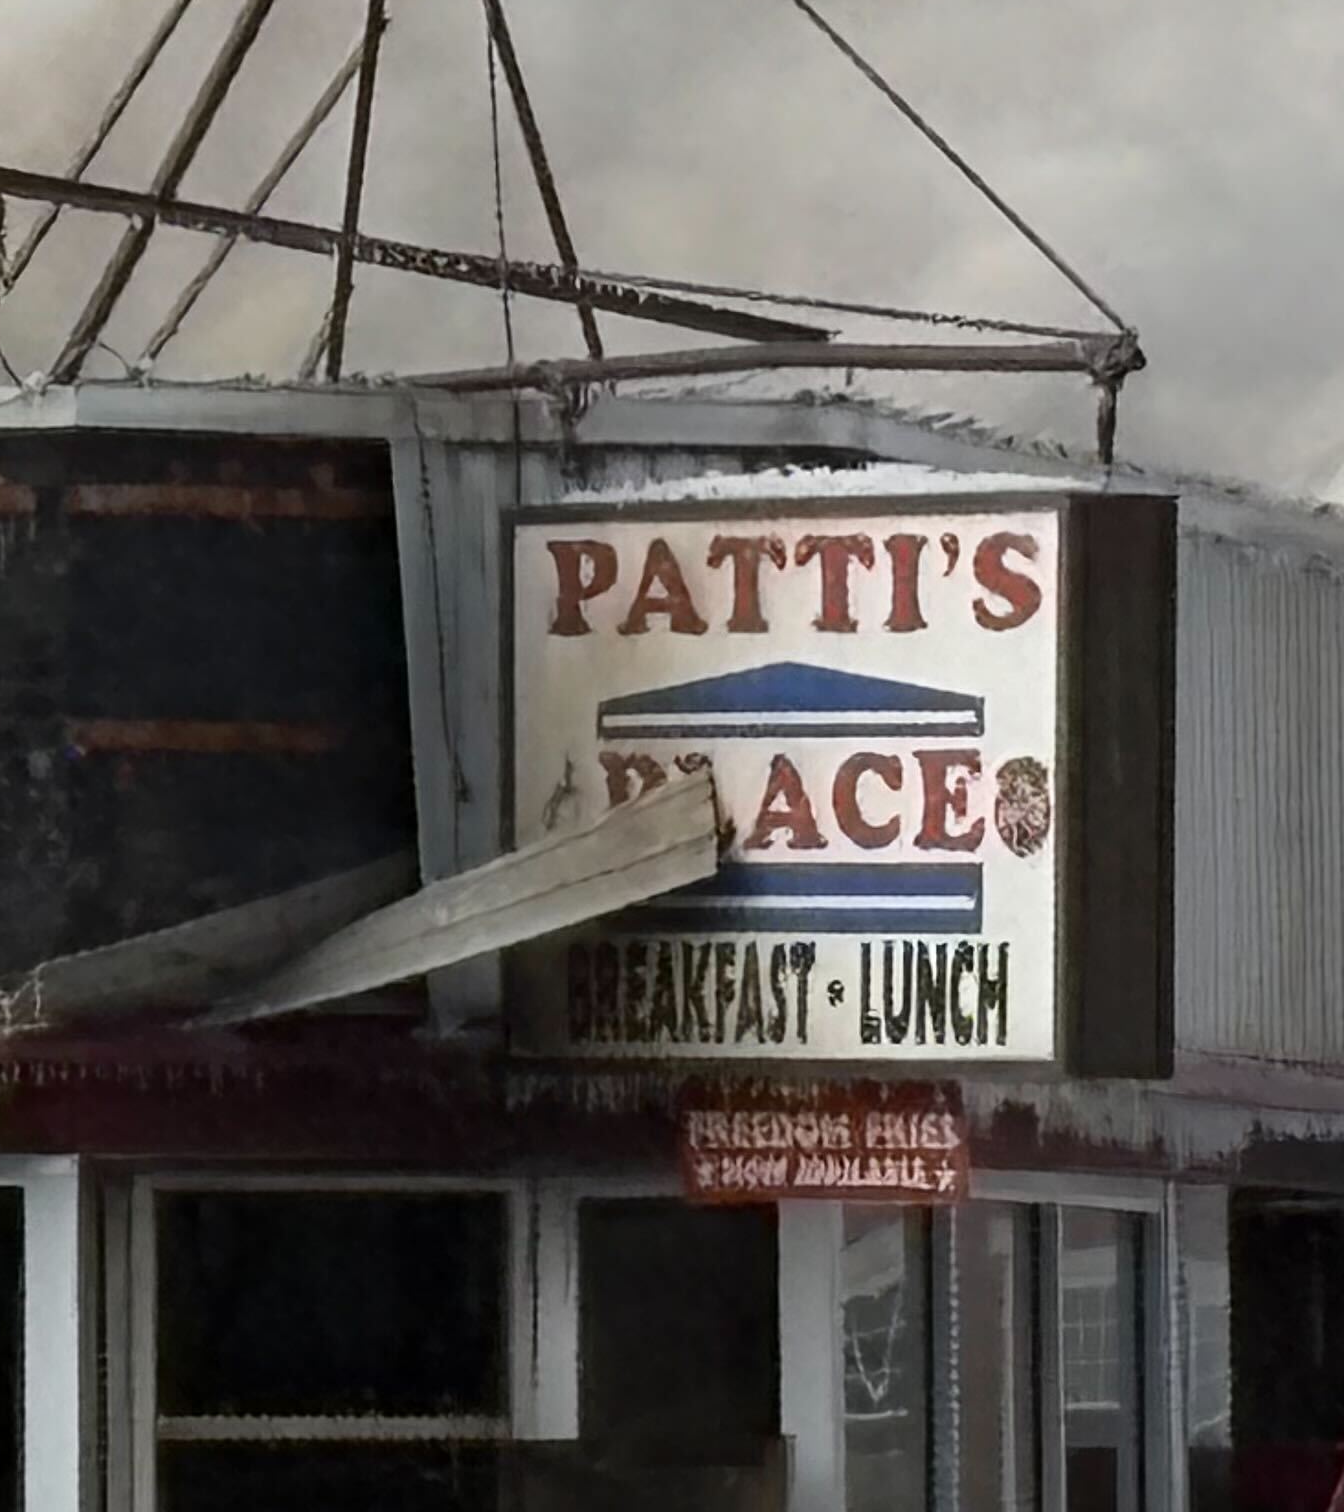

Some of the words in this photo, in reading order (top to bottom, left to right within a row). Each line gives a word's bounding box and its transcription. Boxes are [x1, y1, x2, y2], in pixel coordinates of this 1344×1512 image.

[547, 532, 1042, 636] PATTI'S
[598, 748, 986, 852] PACE
[566, 941, 817, 1045] BREAKFAST
[859, 941, 1010, 1045] LUNCH
